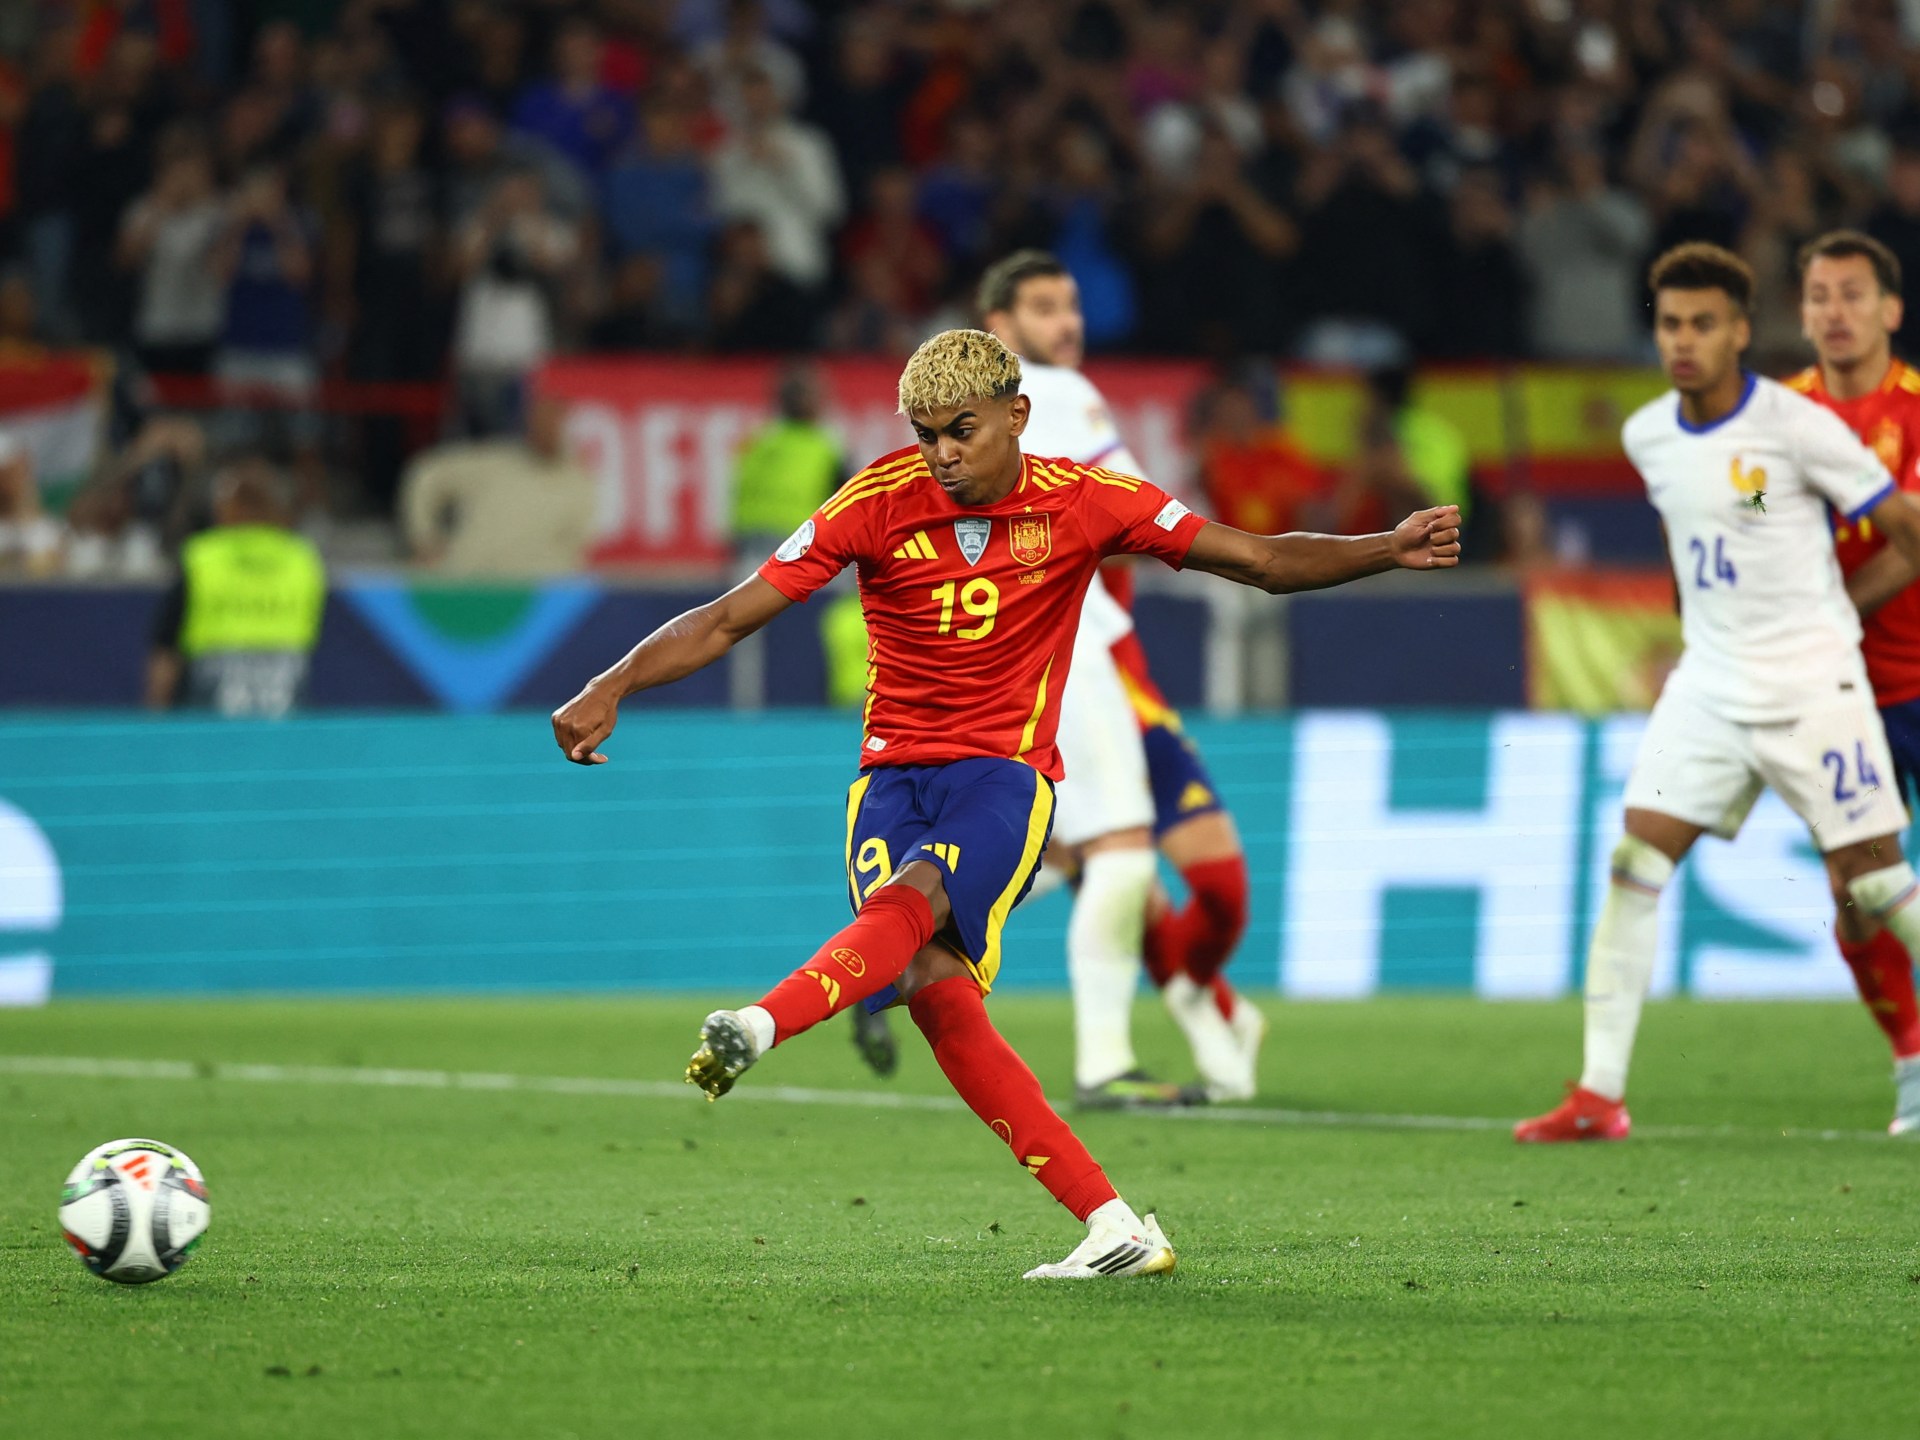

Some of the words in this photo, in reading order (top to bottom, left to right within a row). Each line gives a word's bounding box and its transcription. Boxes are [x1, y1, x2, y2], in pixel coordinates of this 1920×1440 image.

[1689, 536, 1738, 590] 24
[931, 577, 1000, 641] 19
[1822, 741, 1882, 803] 24
[849, 837, 893, 912] 19
